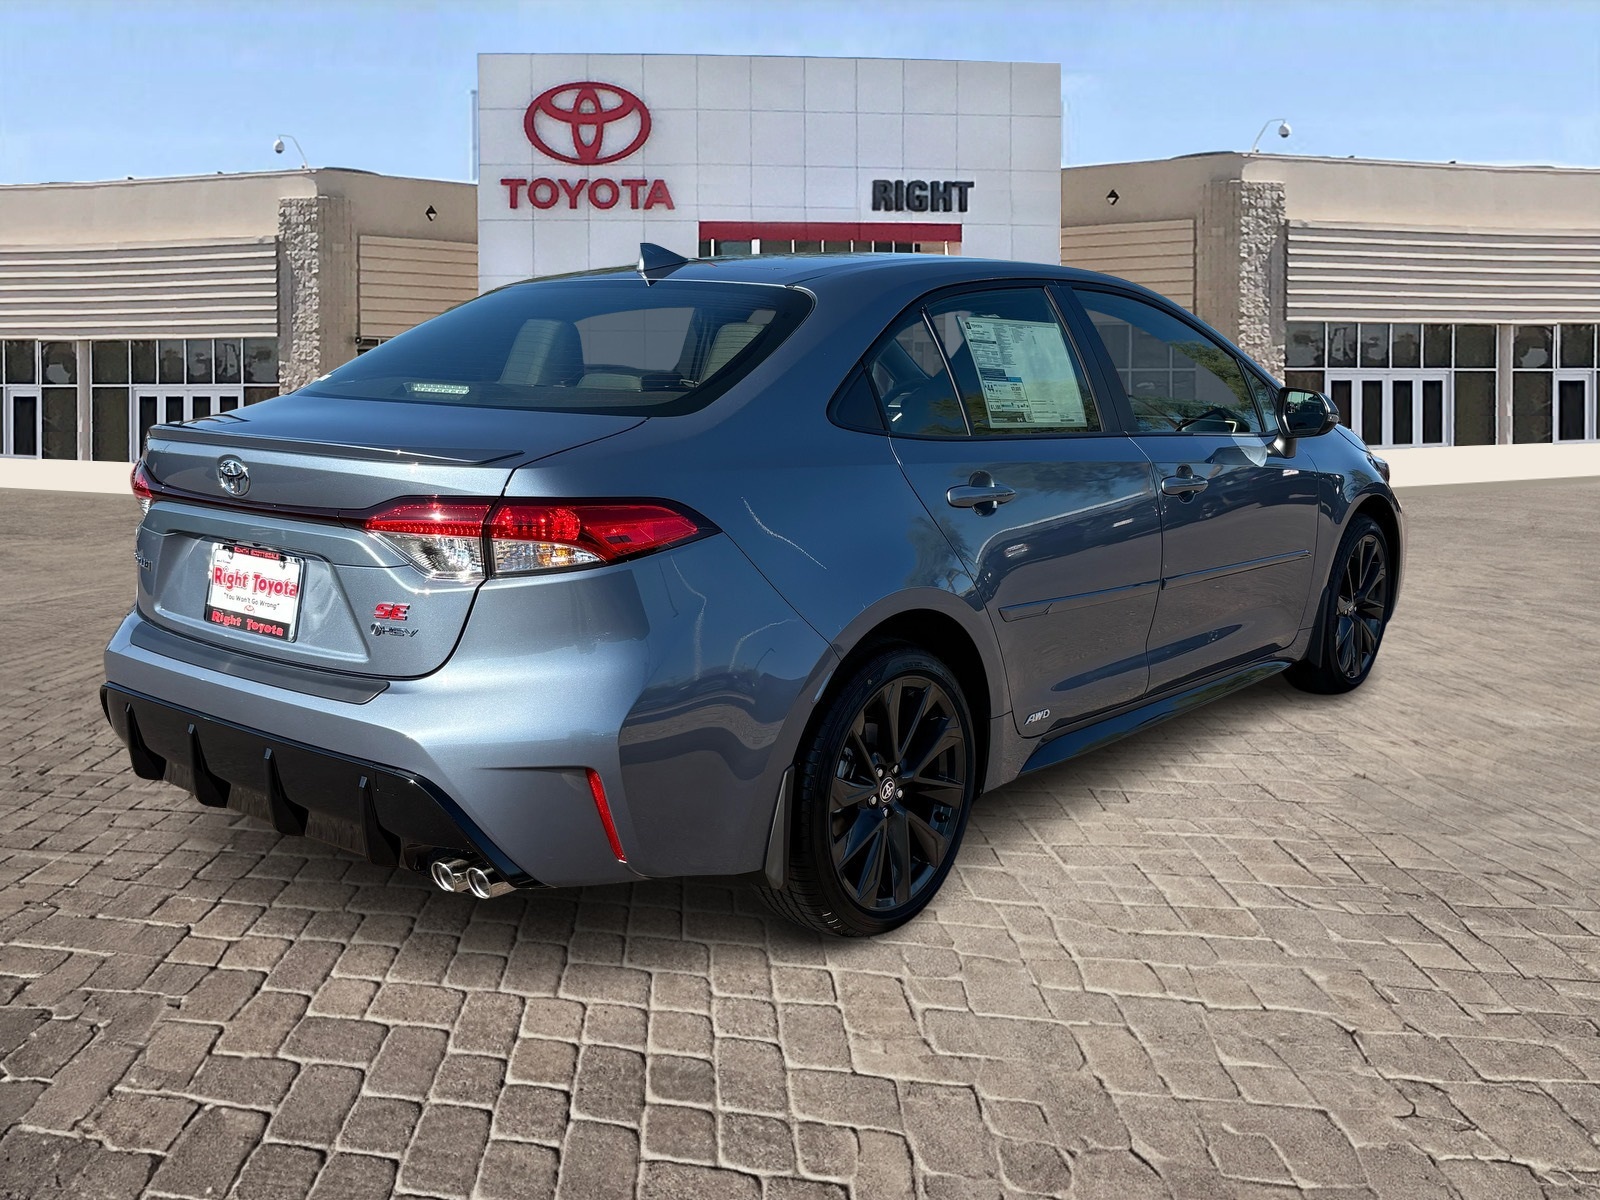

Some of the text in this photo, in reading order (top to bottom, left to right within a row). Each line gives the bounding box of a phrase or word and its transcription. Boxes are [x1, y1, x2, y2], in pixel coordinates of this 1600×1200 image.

[501, 178, 675, 210] TOYOTA
[871, 179, 975, 213] RIGHT
[213, 566, 298, 597] Right Toyota
[235, 595, 251, 603] Won't
[373, 601, 410, 621] SE
[212, 610, 284, 636] Right Toyota
[1024, 708, 1051, 726] AWD
